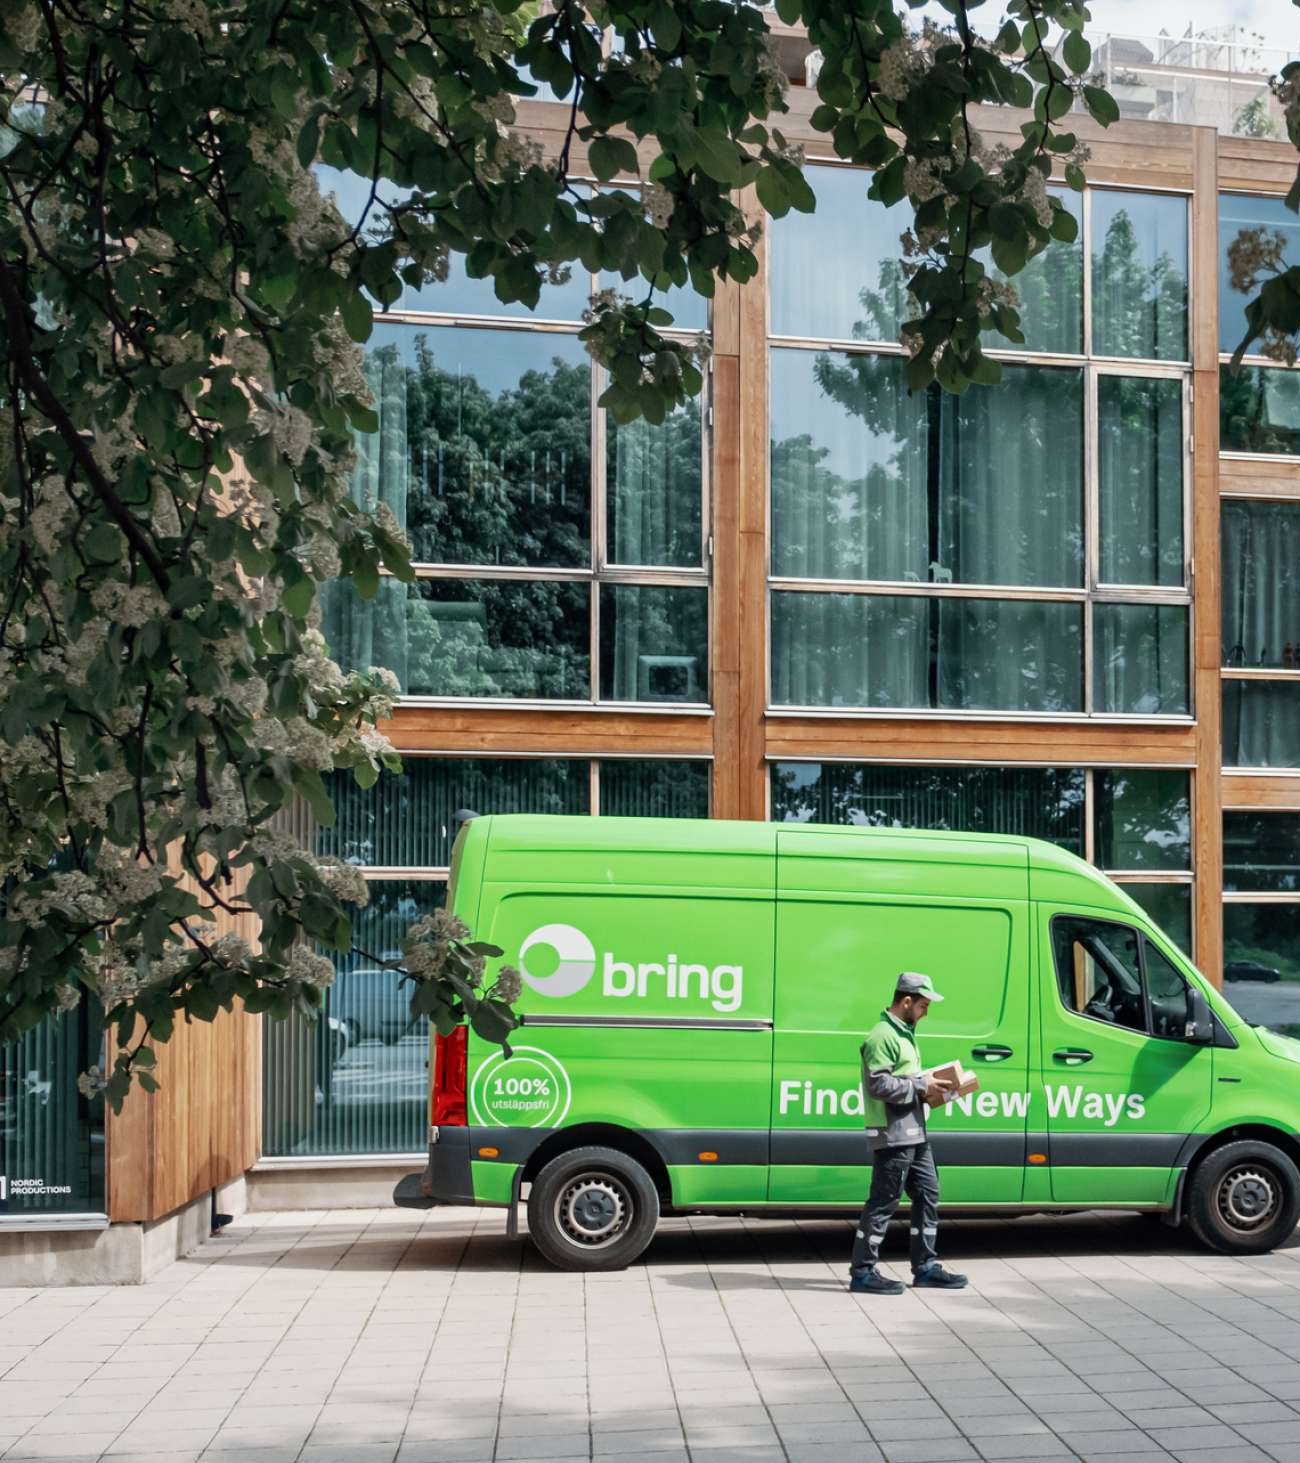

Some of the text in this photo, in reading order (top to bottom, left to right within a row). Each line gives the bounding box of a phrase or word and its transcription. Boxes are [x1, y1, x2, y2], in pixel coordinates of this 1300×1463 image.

[603, 952, 743, 1012] bring
[494, 1078, 550, 1095] 100%
[779, 1080, 1145, 1126] Find New Ways
[10, 1179, 43, 1187] NORDIC
[10, 1186, 72, 1194] PRODUCTIONS
